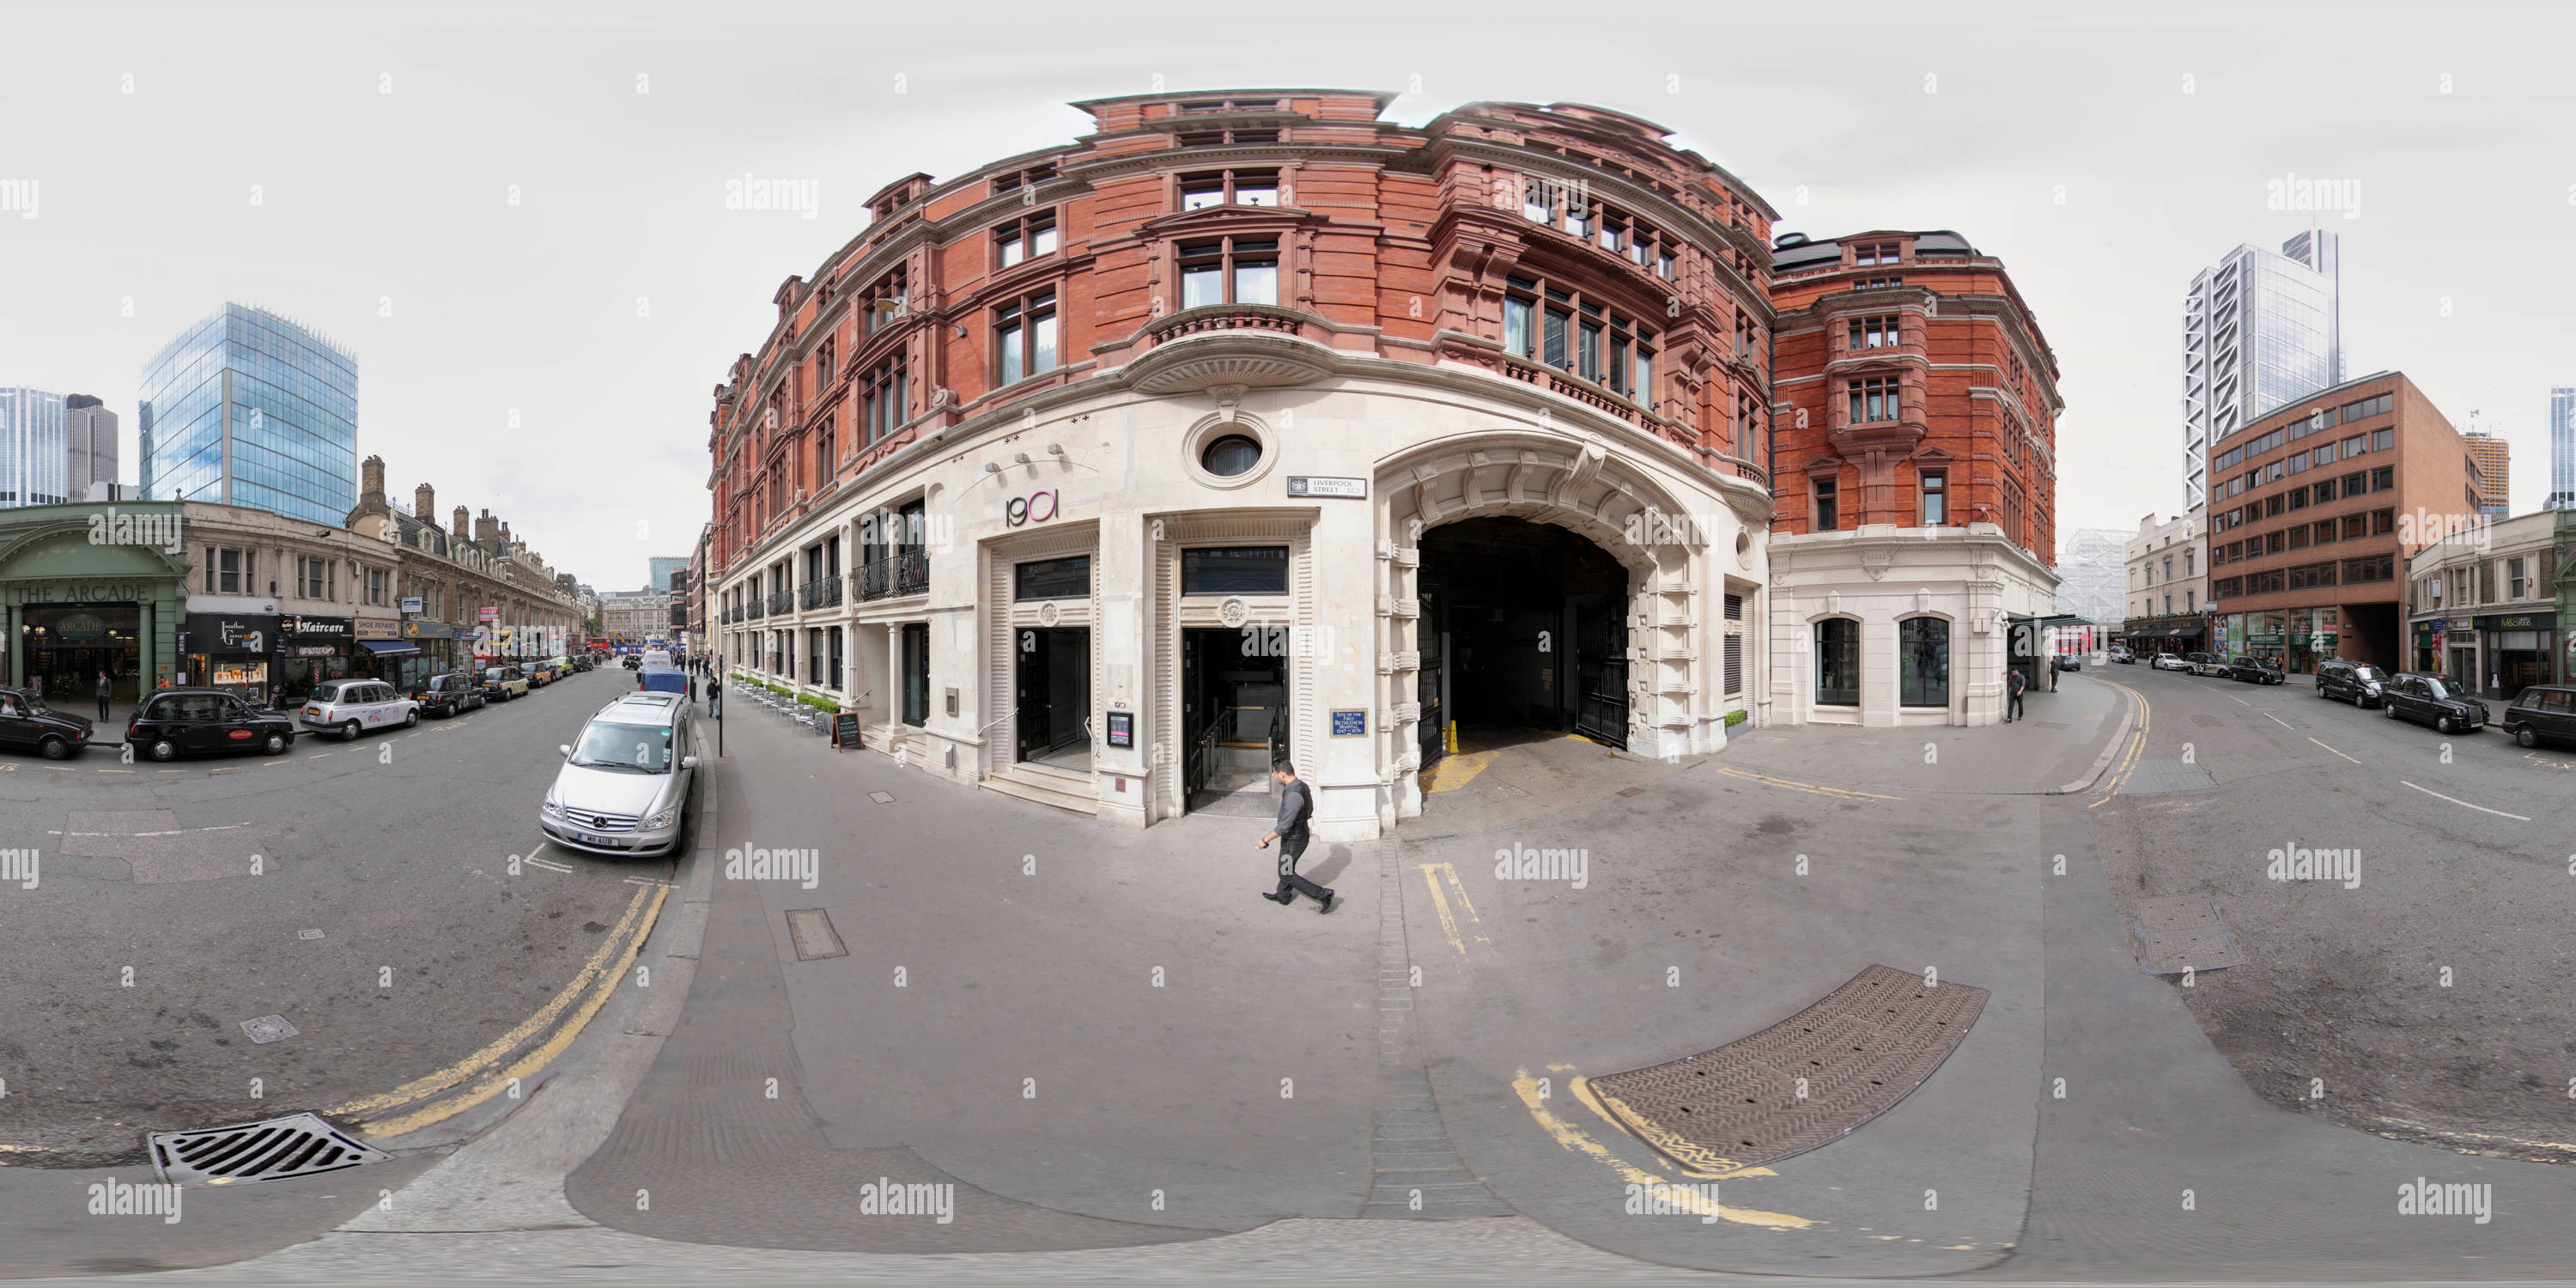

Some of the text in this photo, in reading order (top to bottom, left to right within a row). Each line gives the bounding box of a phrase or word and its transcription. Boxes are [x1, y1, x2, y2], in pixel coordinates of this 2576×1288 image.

[1005, 489, 1059, 528] 1901
[13, 585, 149, 603] THE ARCADE
[59, 619, 102, 633] ARCADE
[220, 621, 245, 640] Jonathan
[301, 621, 344, 633] Haircare
[2501, 617, 2518, 628] M&S
